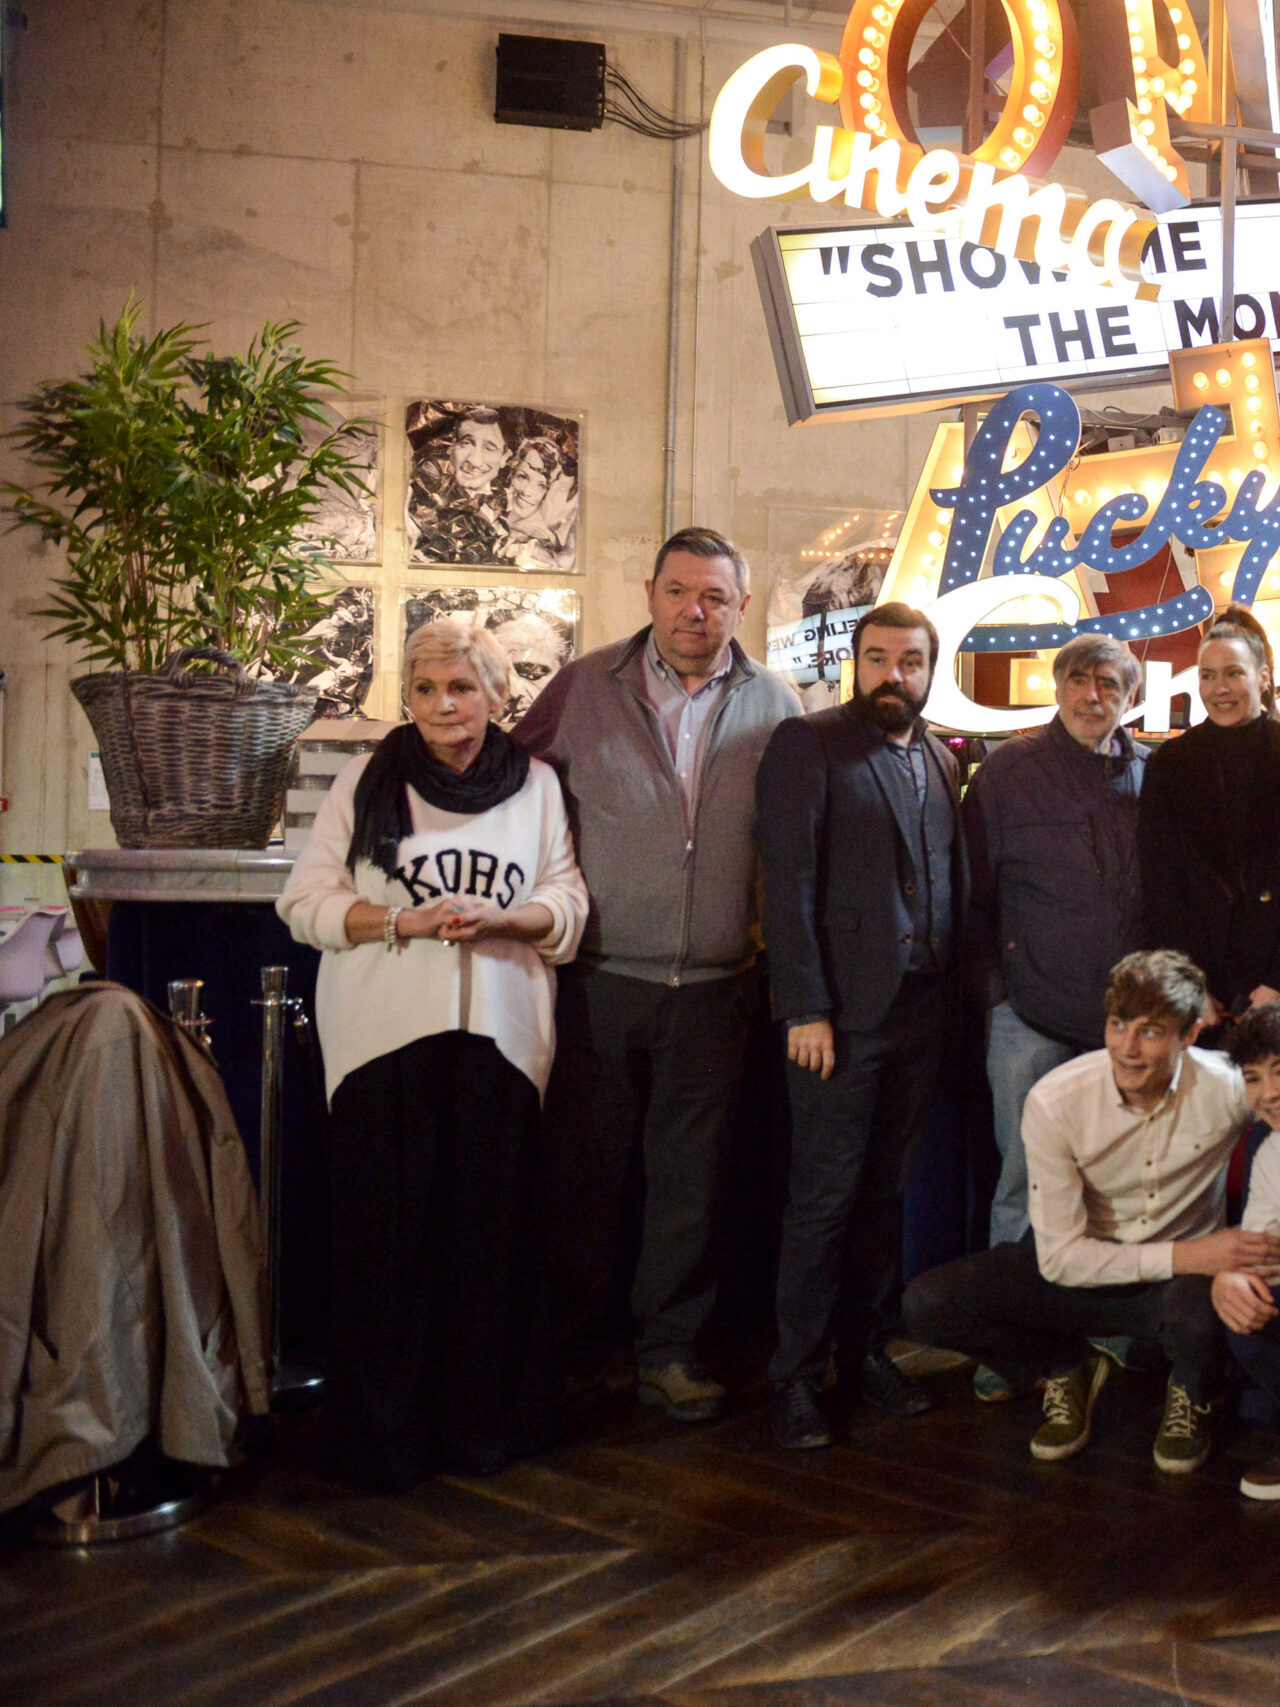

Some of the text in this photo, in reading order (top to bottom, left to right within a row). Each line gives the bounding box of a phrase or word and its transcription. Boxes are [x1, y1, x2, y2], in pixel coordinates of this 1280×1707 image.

[709, 44, 1158, 300] Cinema
[1003, 305, 1138, 366] THE
[396, 848, 525, 909] KORS
